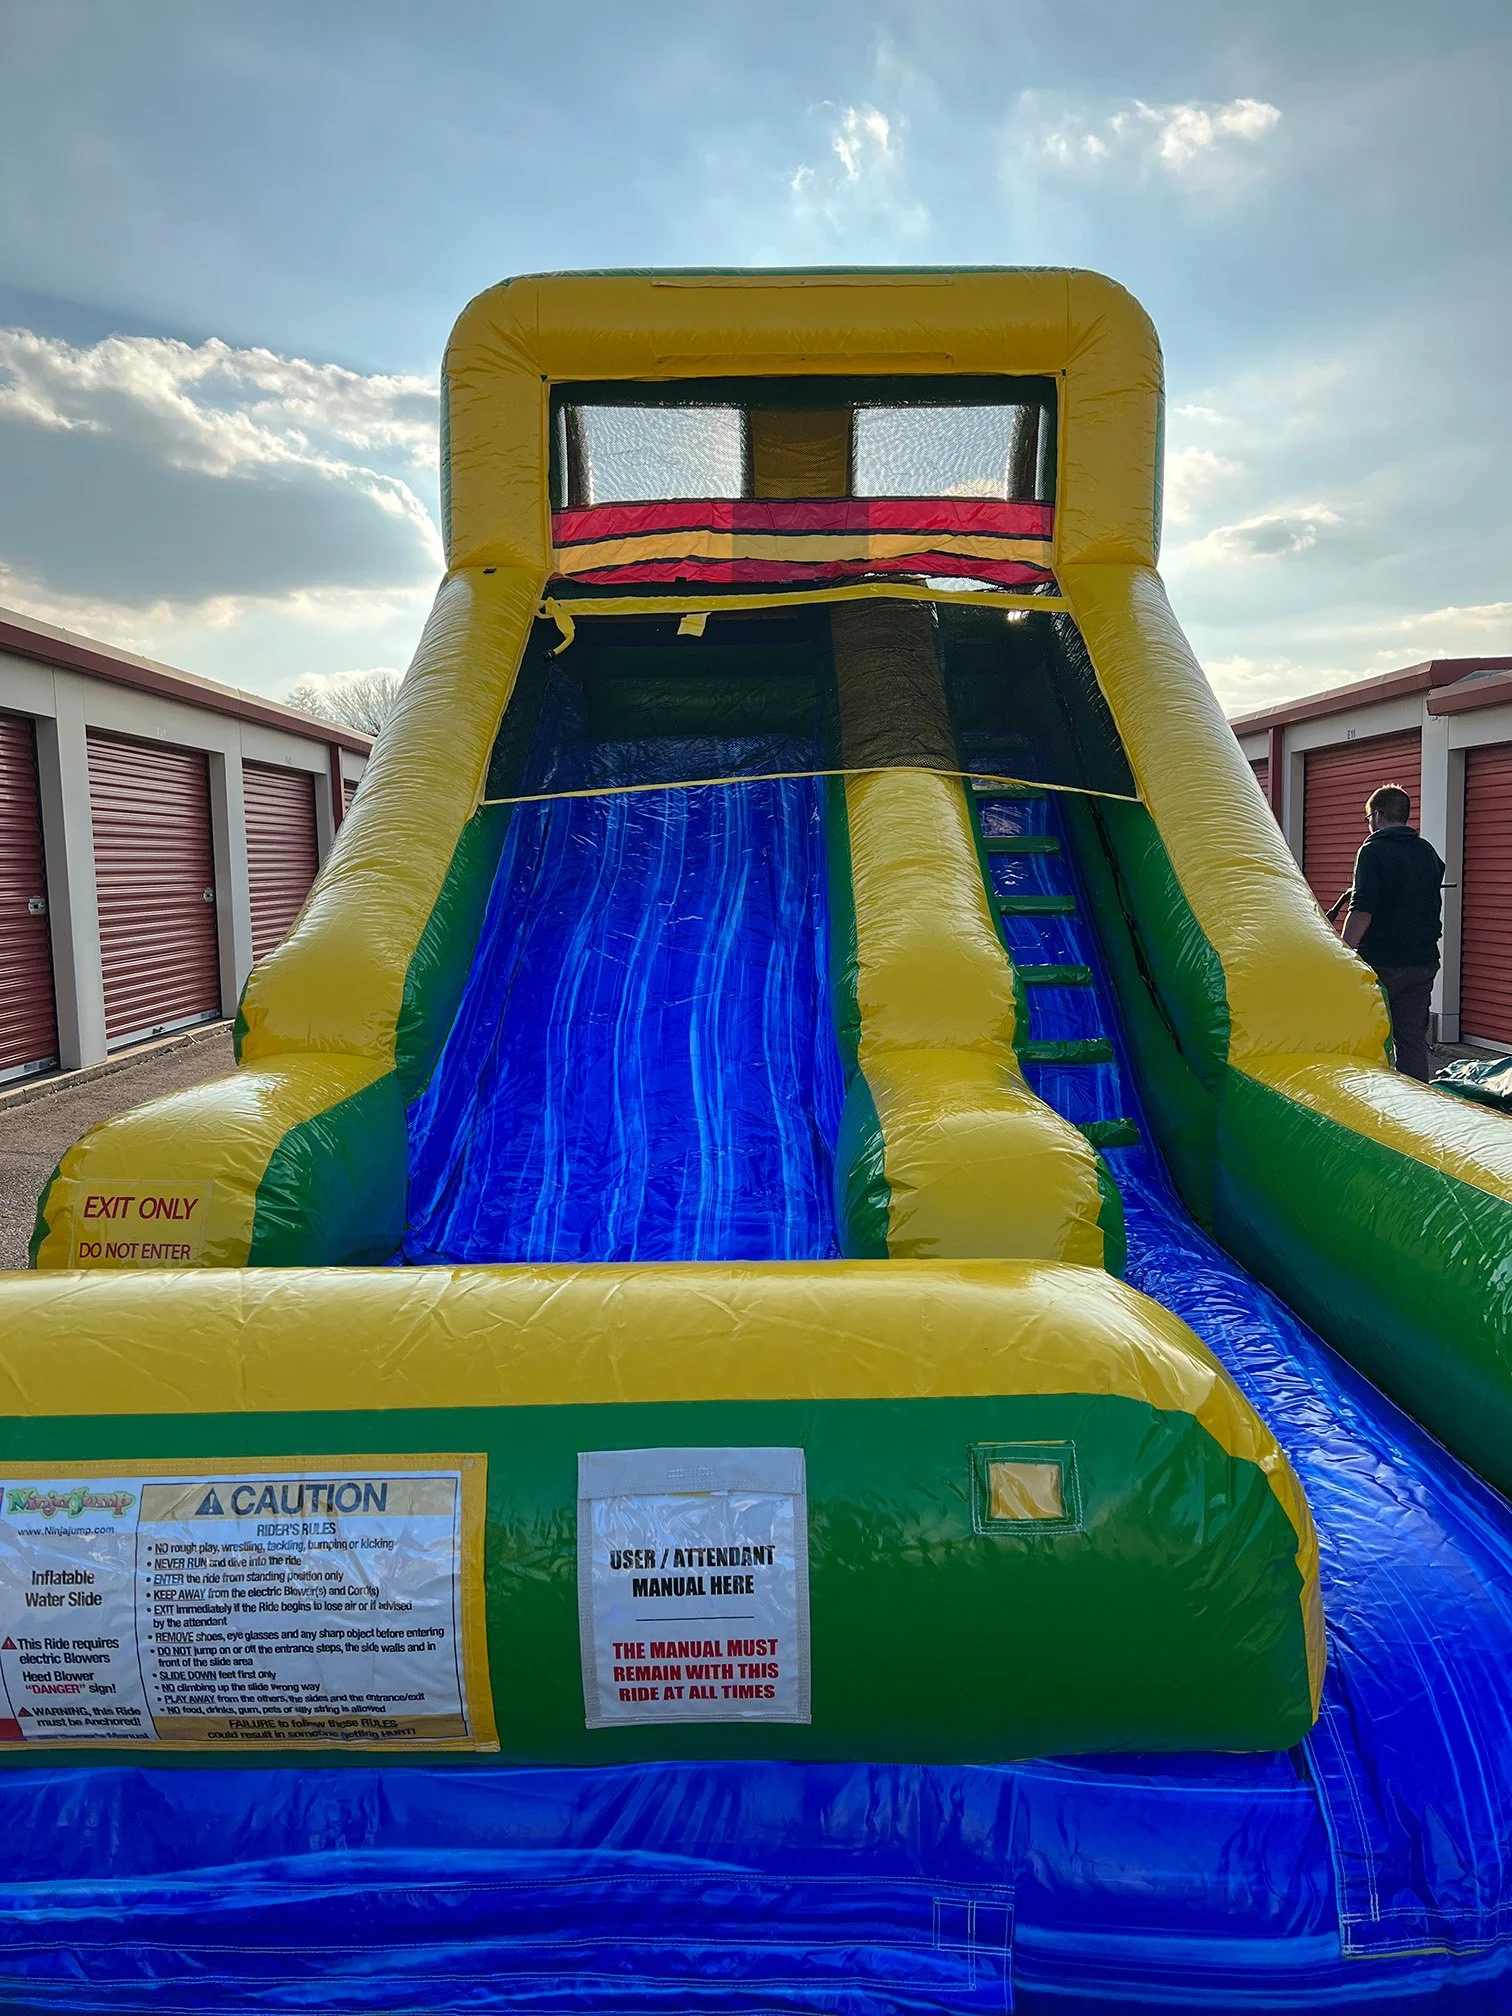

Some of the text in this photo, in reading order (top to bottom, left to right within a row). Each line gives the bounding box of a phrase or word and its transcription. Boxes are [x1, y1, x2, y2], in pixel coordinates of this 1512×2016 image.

[84, 1196, 199, 1220] EXIT ONLY
[79, 1242, 191, 1260] DO NOT ENTER
[231, 1482, 387, 1515] CAUTION
[17, 1526, 115, 1537] www.Ninjajump.com
[257, 1522, 336, 1536] RIDER'S RULES
[155, 1538, 393, 1554] NO rough wrestling, tackling, bumping or kicking
[155, 1555, 302, 1569] NEVER RUN and dive into the ride
[610, 1545, 776, 1570] USER ATTENDANT
[31, 1570, 95, 1585] Inflatable
[154, 1570, 344, 1584] ENTER the ride from standing position only
[154, 1585, 380, 1600] KEEP AWAY from the electric Blower(s) and Cord(s)
[632, 1575, 755, 1598] MANUAL HERE
[25, 1592, 102, 1607] Water Slide
[154, 1600, 412, 1615] EXIT immediately if the Ride begins to lose air or if advised
[153, 1617, 227, 1629] by the attendant
[155, 1627, 444, 1642] REMOVE shoes, eye glasses and any sharp object before entering
[17, 1637, 119, 1651] This Ride requires
[157, 1647, 171, 1656] DO
[173, 1647, 192, 1656] NOT
[194, 1646, 217, 1657] jump
[233, 1646, 242, 1654] or
[244, 1645, 256, 1654] off
[258, 1645, 272, 1654] the
[275, 1644, 314, 1654] entrance
[316, 1643, 343, 1653] steps,
[345, 1642, 359, 1652] the
[361, 1642, 379, 1652] side
[381, 1642, 405, 1653] walls
[407, 1642, 425, 1652] and
[427, 1641, 436, 1651] in
[613, 1639, 778, 1659] THE MANUAL MUST
[20, 1652, 111, 1664] electric Blowers
[158, 1657, 253, 1667] front of the slide area
[22, 1671, 94, 1682] Heed Blower
[160, 1670, 276, 1680] SLIDE DOWN feet first only
[613, 1663, 779, 1682] REMAIN WITH THIS
[89, 1684, 116, 1695] sign!
[162, 1683, 320, 1693] NO climbing up the slide wrong way
[619, 1685, 775, 1702] RIDE AT ALL TIMES
[165, 1695, 186, 1704] PLAY
[189, 1695, 214, 1704] AWAY
[288, 1695, 302, 1703] the
[305, 1694, 328, 1703] sides
[330, 1693, 347, 1703] and
[349, 1693, 363, 1702] the
[366, 1692, 425, 1702] entrance/exit
[32, 1707, 141, 1717] WARNING, this Ride
[167, 1706, 181, 1714] NO
[263, 1706, 282, 1715] pets
[314, 1705, 340, 1715] string
[351, 1705, 386, 1713] allowed
[37, 1717, 141, 1727] must be Anchored!
[229, 1718, 398, 1729] FAILURE to RULES
[208, 1731, 285, 1739] could result in
